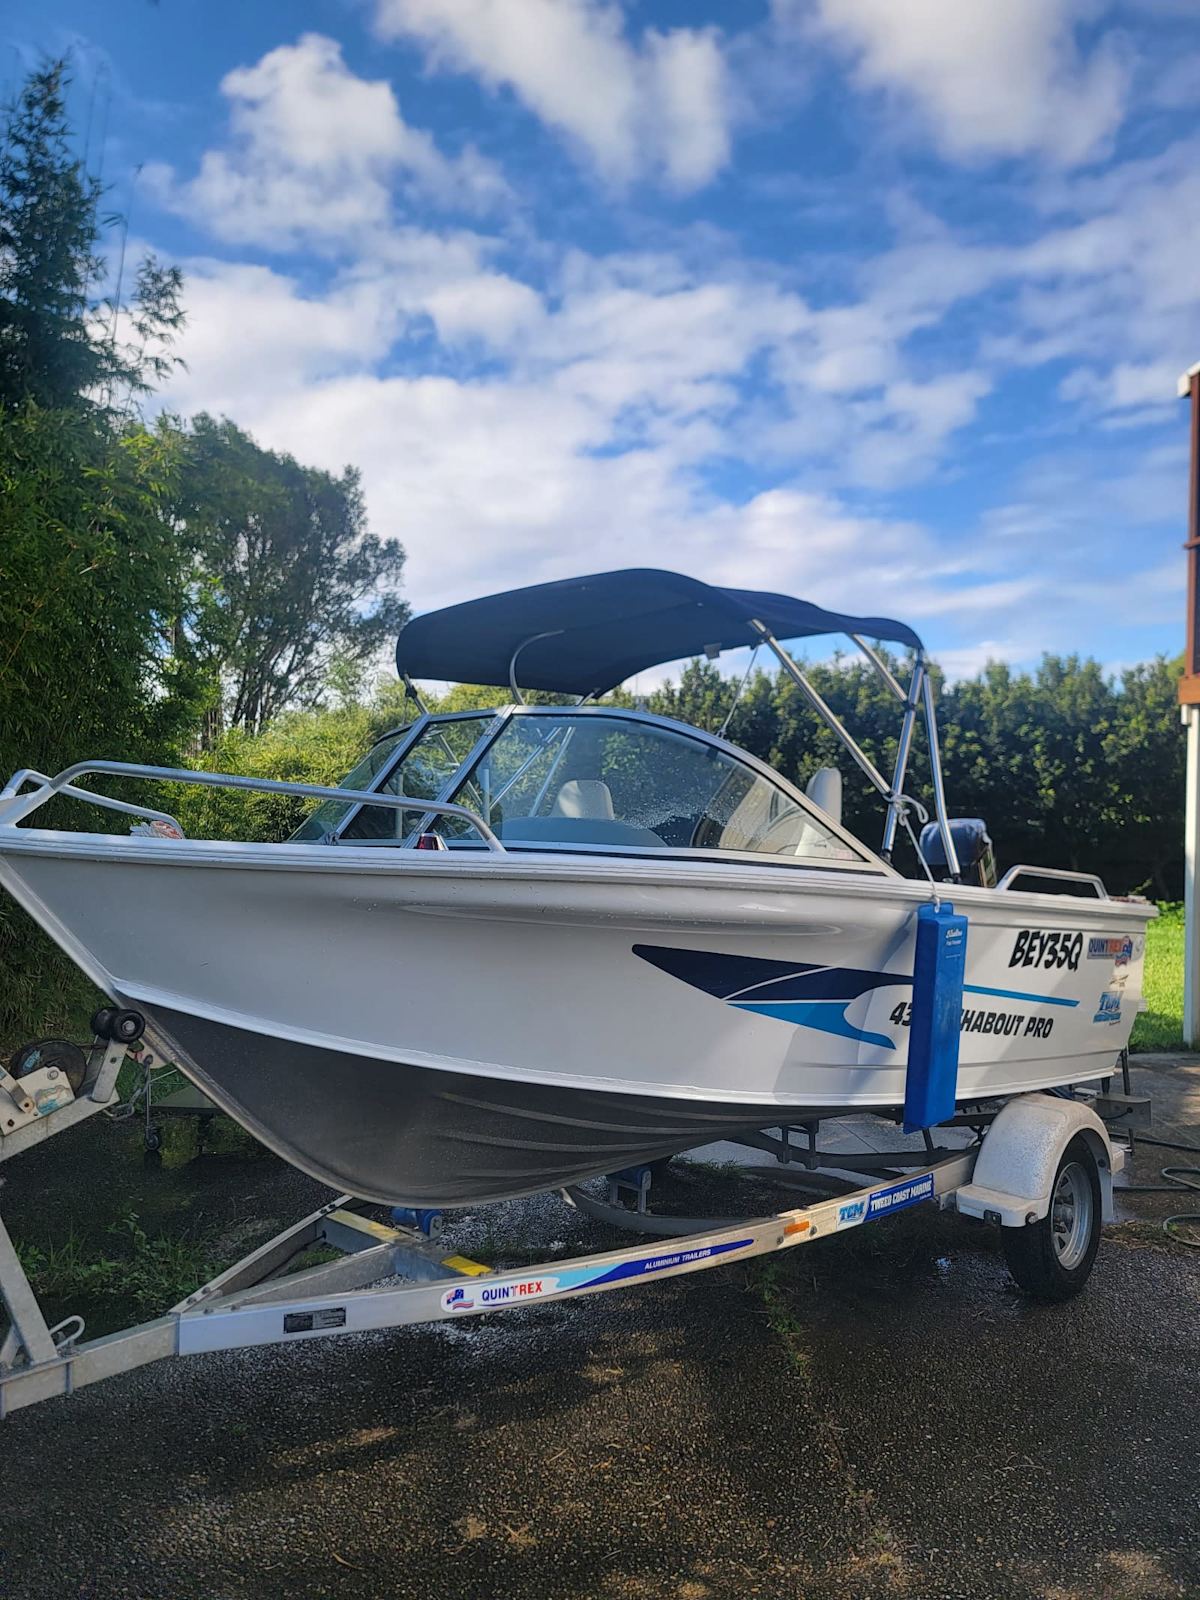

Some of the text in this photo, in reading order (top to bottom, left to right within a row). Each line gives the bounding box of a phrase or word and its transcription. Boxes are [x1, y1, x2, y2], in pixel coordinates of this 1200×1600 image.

[1008, 930, 1083, 972] BEY35Q
[889, 1002, 1054, 1039] 43 HABOUT PRO
[839, 1180, 932, 1220] TCM TWEED COAST MARINE
[644, 1249, 712, 1270] ALUMINIUM TRAILERS
[482, 1281, 542, 1301] QUINTREX
